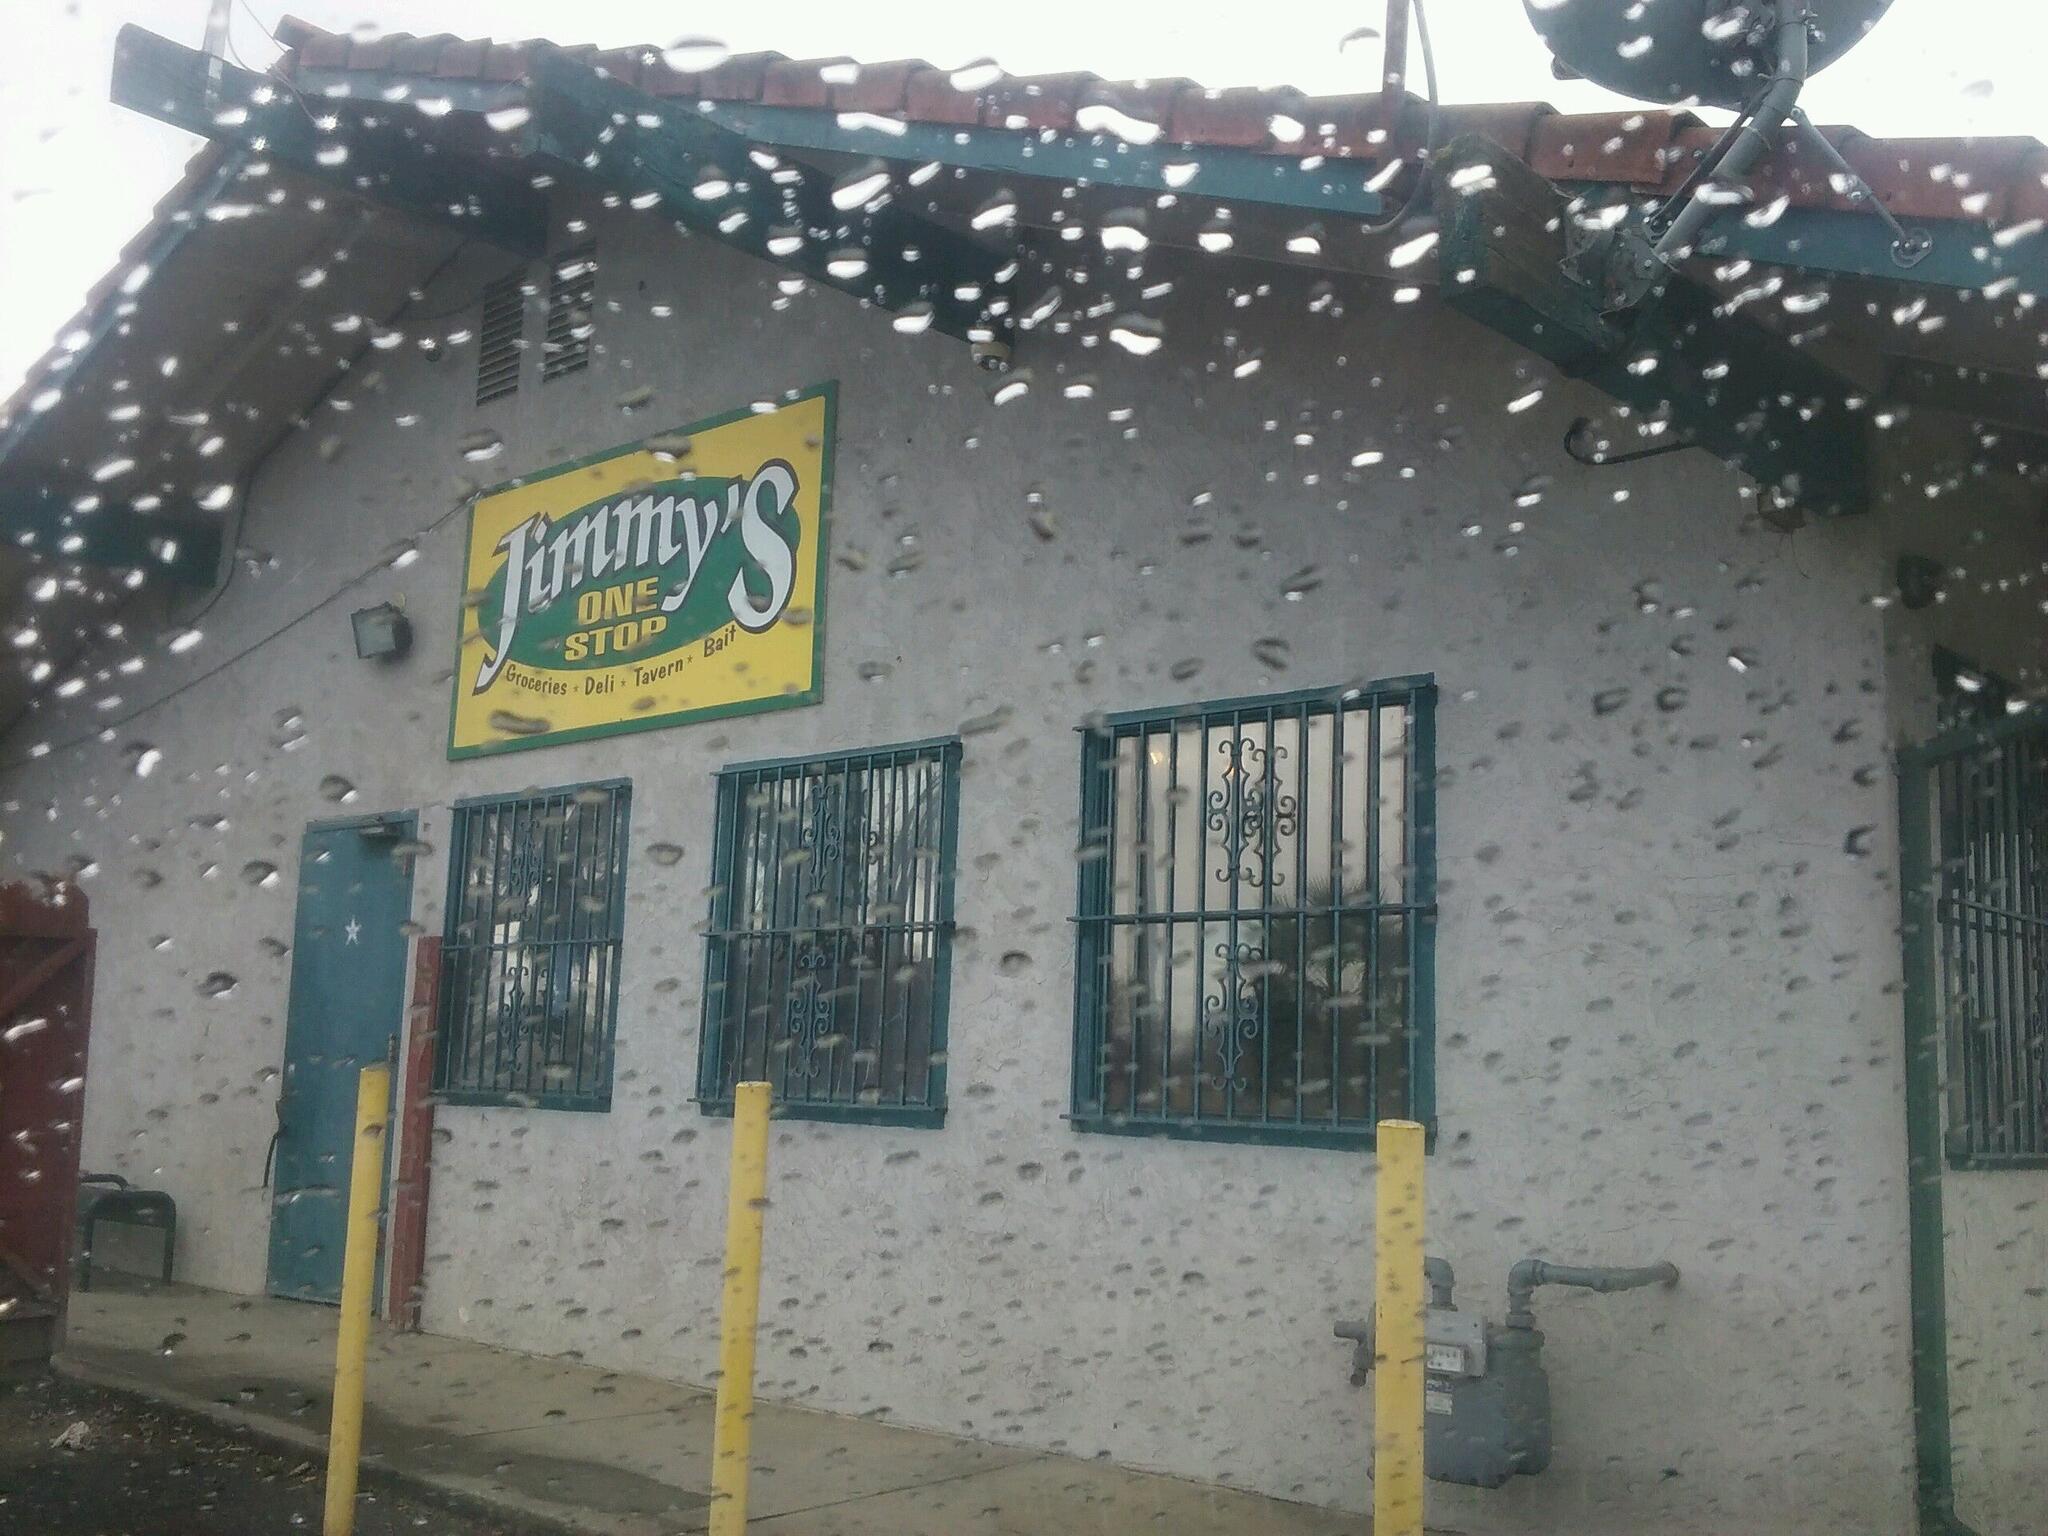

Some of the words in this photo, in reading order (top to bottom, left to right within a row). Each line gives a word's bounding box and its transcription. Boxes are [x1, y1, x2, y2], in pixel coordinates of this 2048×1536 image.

[577, 576, 660, 626] ONE
[505, 663, 567, 696] Groceries
[585, 674, 614, 695] Deli
[633, 657, 683, 687] Tavern
[703, 624, 737, 658] Bait
[564, 615, 668, 662] STOP
